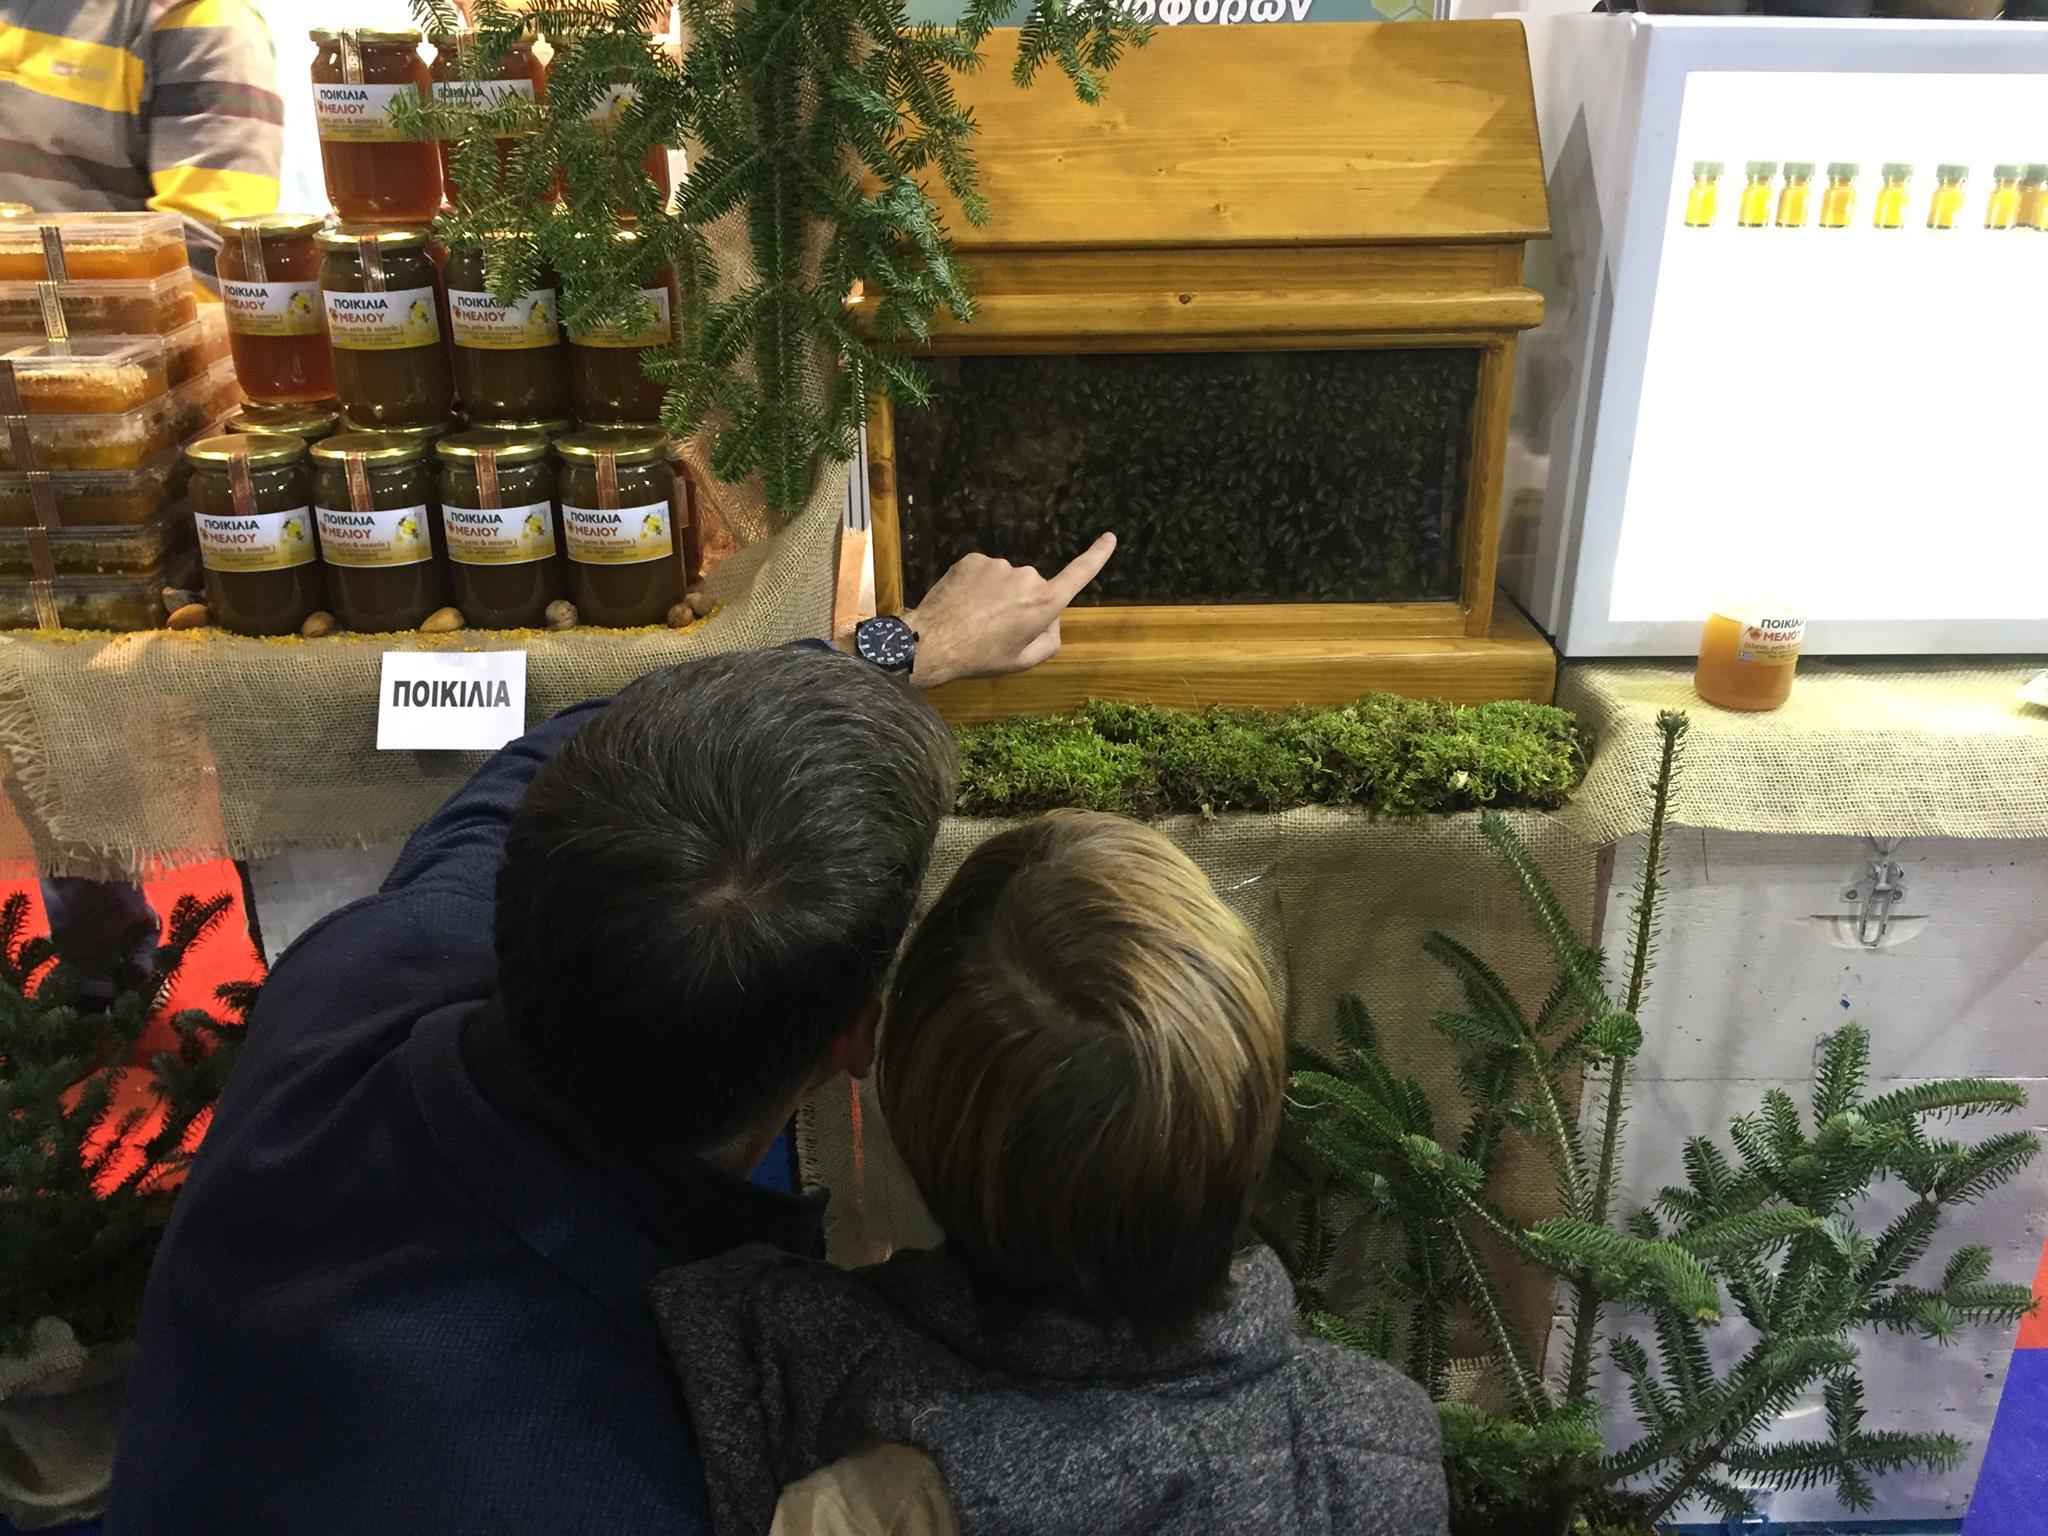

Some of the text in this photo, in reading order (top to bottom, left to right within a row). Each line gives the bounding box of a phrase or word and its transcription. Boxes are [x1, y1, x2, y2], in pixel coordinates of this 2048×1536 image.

[320, 89, 369, 101] ΠΟΙΚΙΛΙΑ
[325, 103, 365, 114] ΜΕΛΙΟΥ
[333, 298, 388, 310] ΠΟΙΚΙΛΙΑ
[457, 296, 503, 309] ΠΟΙΚΙΛ
[339, 312, 385, 323] ΜΕΛΙΟΥ
[462, 310, 506, 322] ΜΕΛΙΟΥ
[323, 513, 376, 526] ΠΟΙΚΙΛΙΑ
[450, 511, 503, 524] ΠΟΙΚΙΛΙΑ
[570, 511, 622, 524] ΠΟΙΚΙΛΙΑ
[204, 519, 260, 531] ΠΟΙΚΙΛΙΑ
[455, 525, 500, 537] ΜΕΛΙΟΥ
[575, 525, 619, 537] ΜΕΛΙΟΥ
[209, 532, 257, 543] ΜΕΛΙΟΥ
[328, 527, 372, 539] ΜΕΛΙΟΥ
[392, 680, 511, 708] ΠΟΙΚΙΛΙΑ
